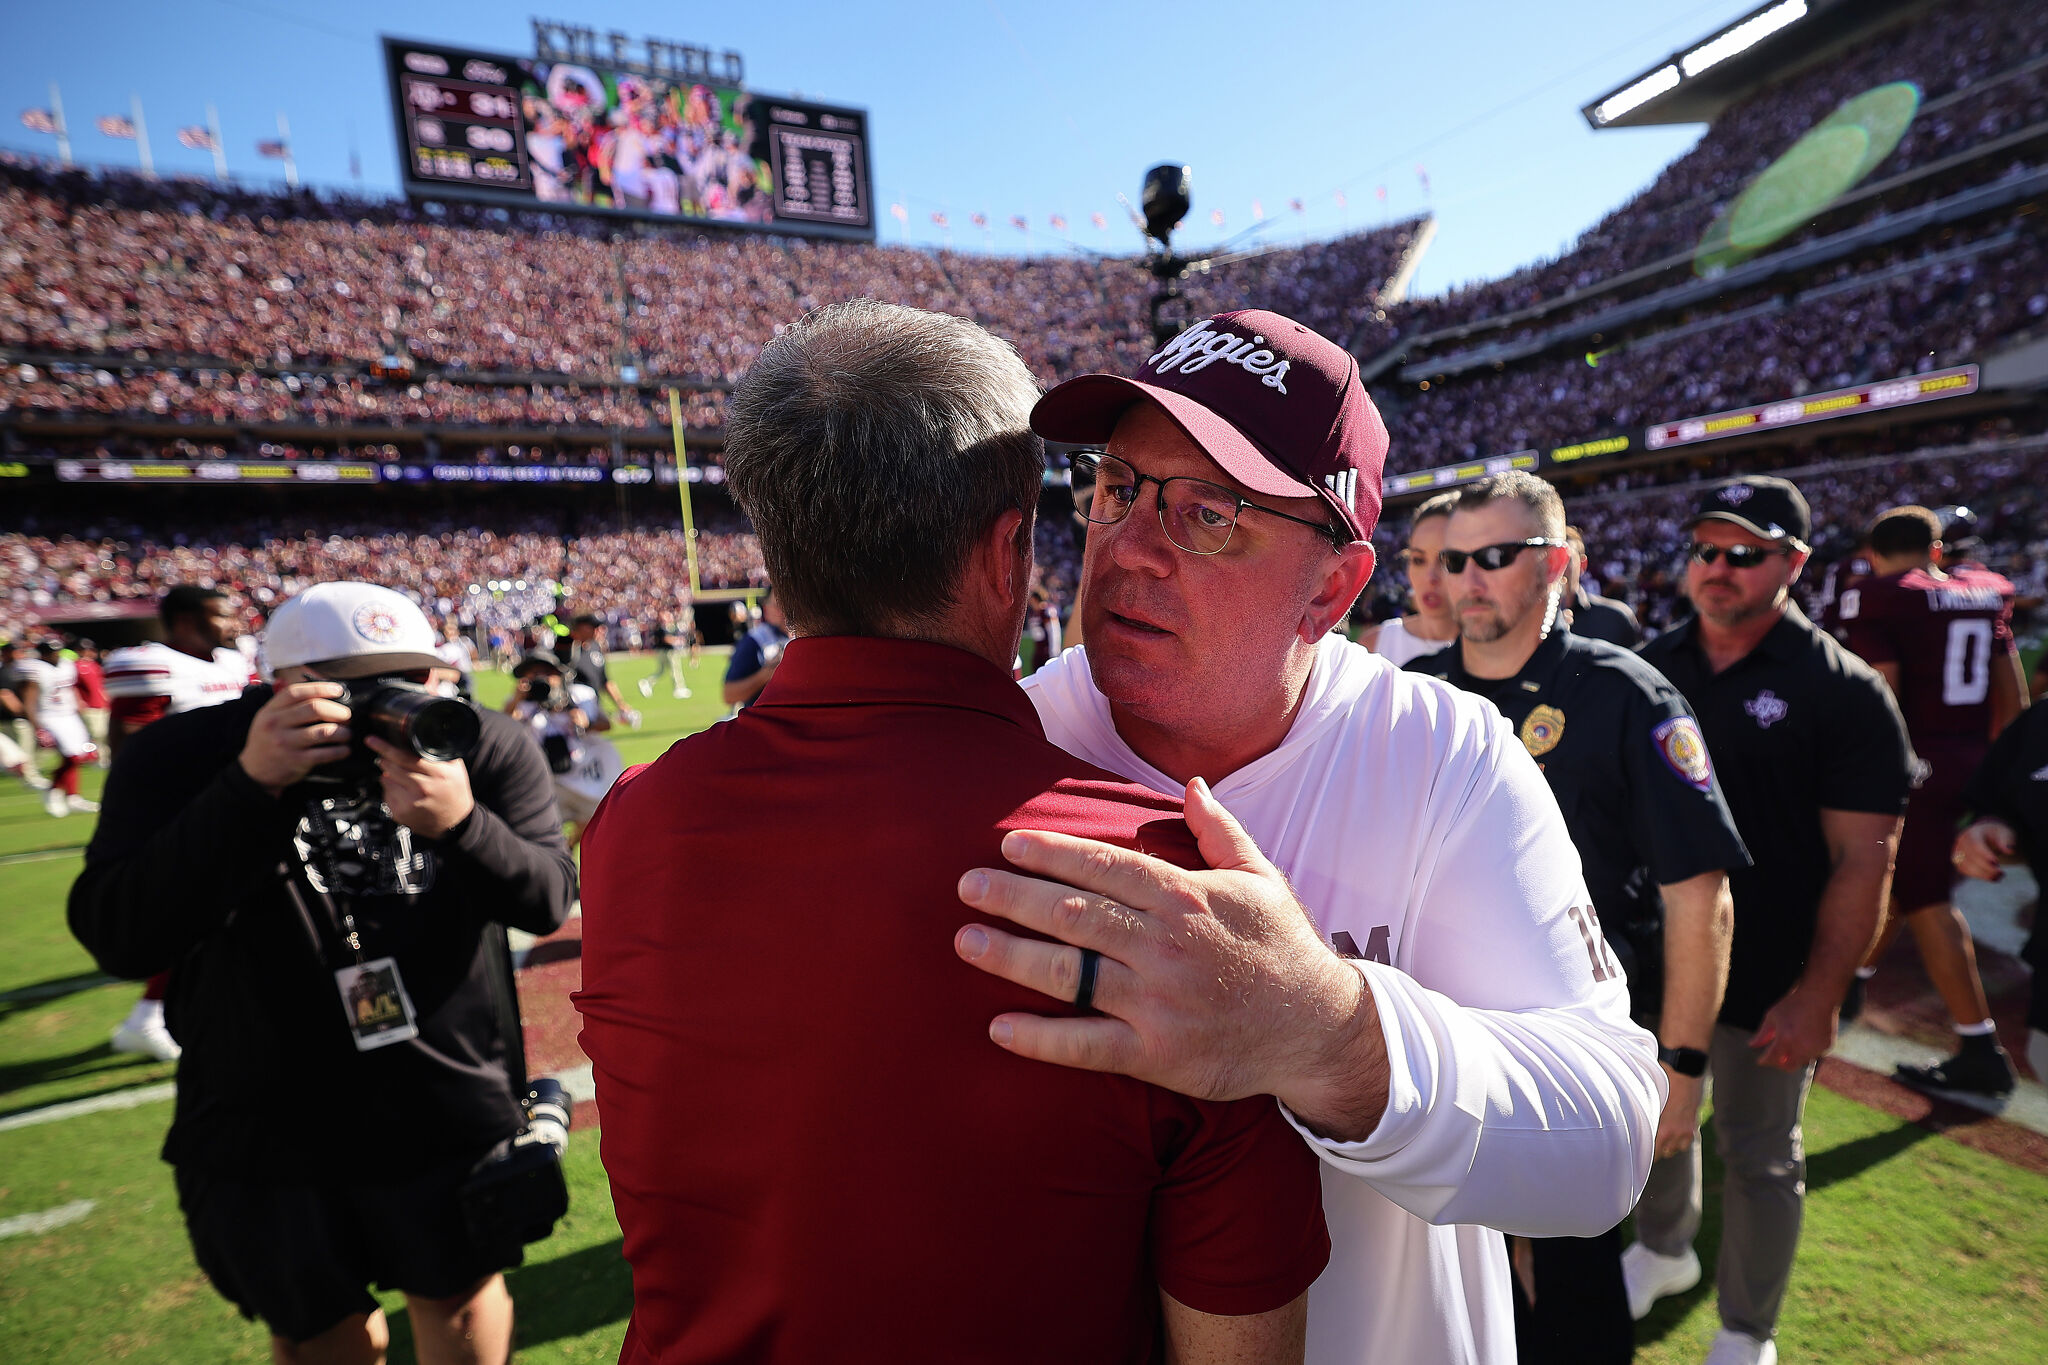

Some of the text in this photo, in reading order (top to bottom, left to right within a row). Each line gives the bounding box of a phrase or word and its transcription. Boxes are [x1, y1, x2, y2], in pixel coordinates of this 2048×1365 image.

[532, 17, 745, 88] KYLE FIELD
[1148, 319, 1291, 396] Aggies
[1943, 619, 1993, 706] 0
[1331, 925, 1392, 966] M
